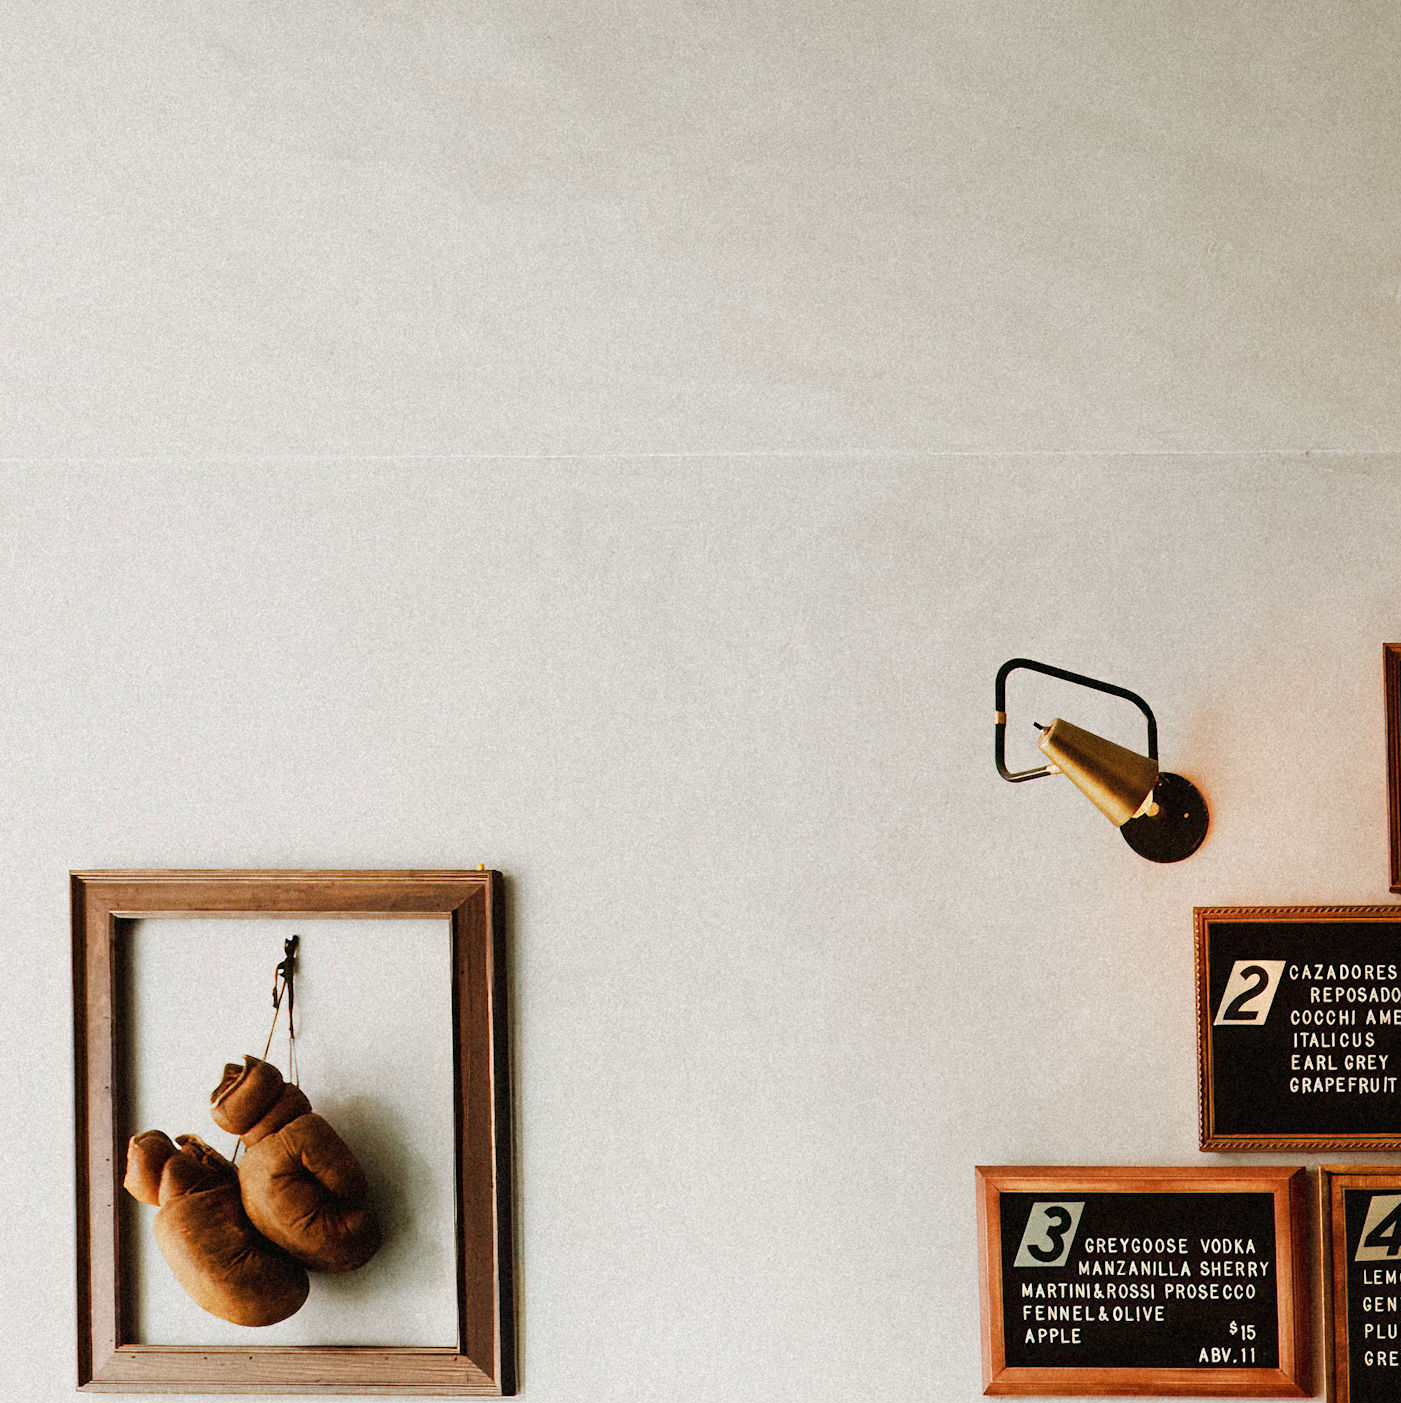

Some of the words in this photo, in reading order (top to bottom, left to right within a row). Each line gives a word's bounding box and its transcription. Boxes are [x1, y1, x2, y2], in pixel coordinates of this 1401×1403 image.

[1290, 964, 1397, 980] CAZADORES
[1222, 964, 1270, 1022] 2
[1311, 987, 1401, 1003] REPOSADO
[1291, 1010, 1355, 1025] COCCHI
[1294, 1032, 1375, 1048] ITALICUS
[1292, 1055, 1337, 1071] EARL
[1345, 1055, 1388, 1070] GREY
[1290, 1076, 1397, 1094] GRAPEFRUIT
[1027, 1205, 1072, 1262] 3
[1085, 1238, 1188, 1253] GREYGOOSE
[1200, 1239, 1255, 1254] VODKA
[1079, 1261, 1191, 1276] MANZANILLA
[1200, 1261, 1268, 1277] SHERRY
[1165, 1283, 1255, 1299] PROSECCO
[1025, 1328, 1081, 1343] APPLE
